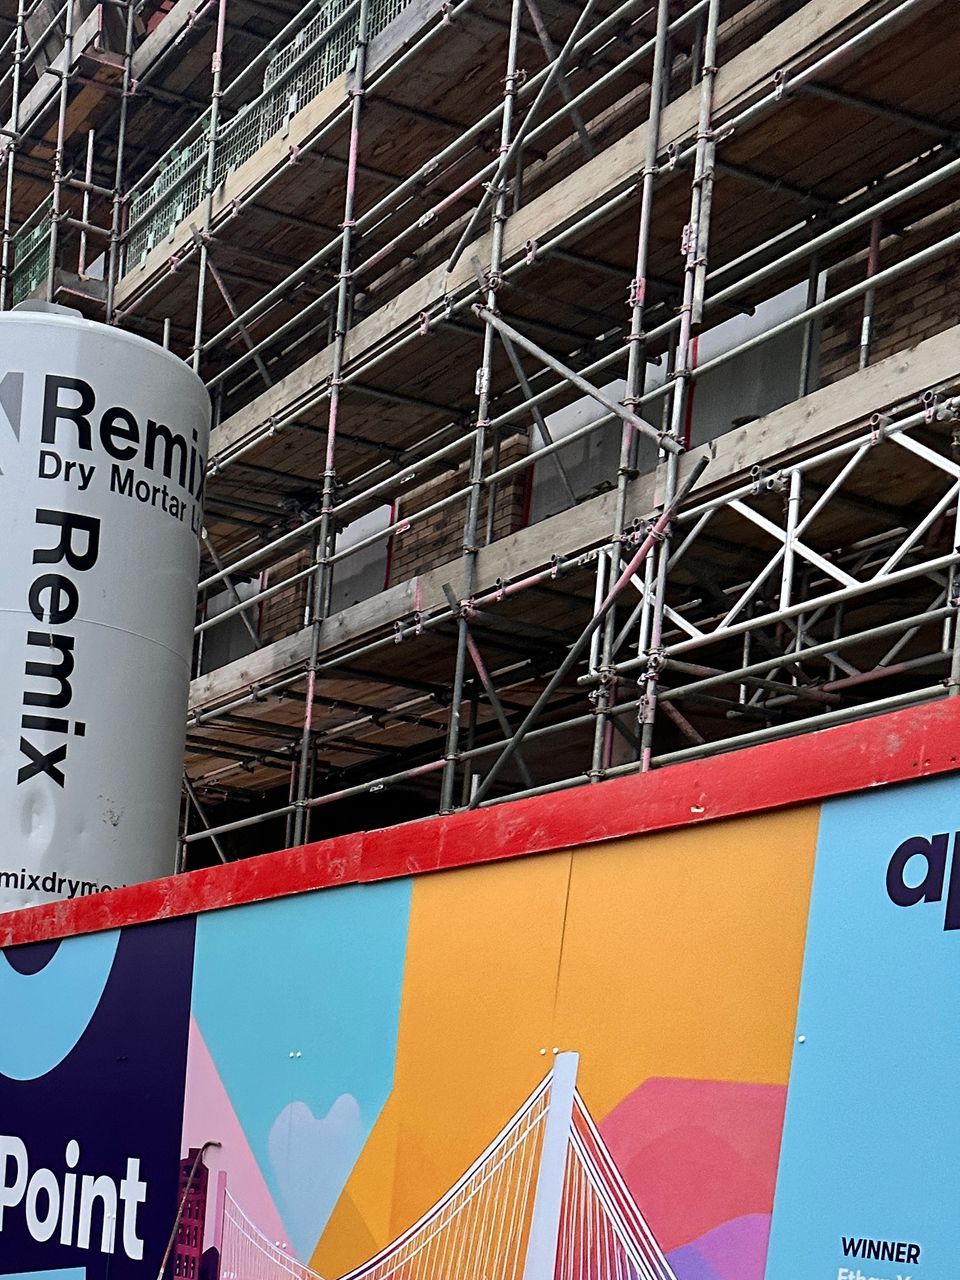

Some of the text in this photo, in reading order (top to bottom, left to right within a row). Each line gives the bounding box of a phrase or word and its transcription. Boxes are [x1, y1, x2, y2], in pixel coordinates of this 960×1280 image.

[39, 450, 96, 491] Dry
[110, 463, 186, 522] Mortar
[41, 374, 208, 502] Remix
[17, 508, 101, 789] Remix
[841, 1236, 921, 1264] WINNER
